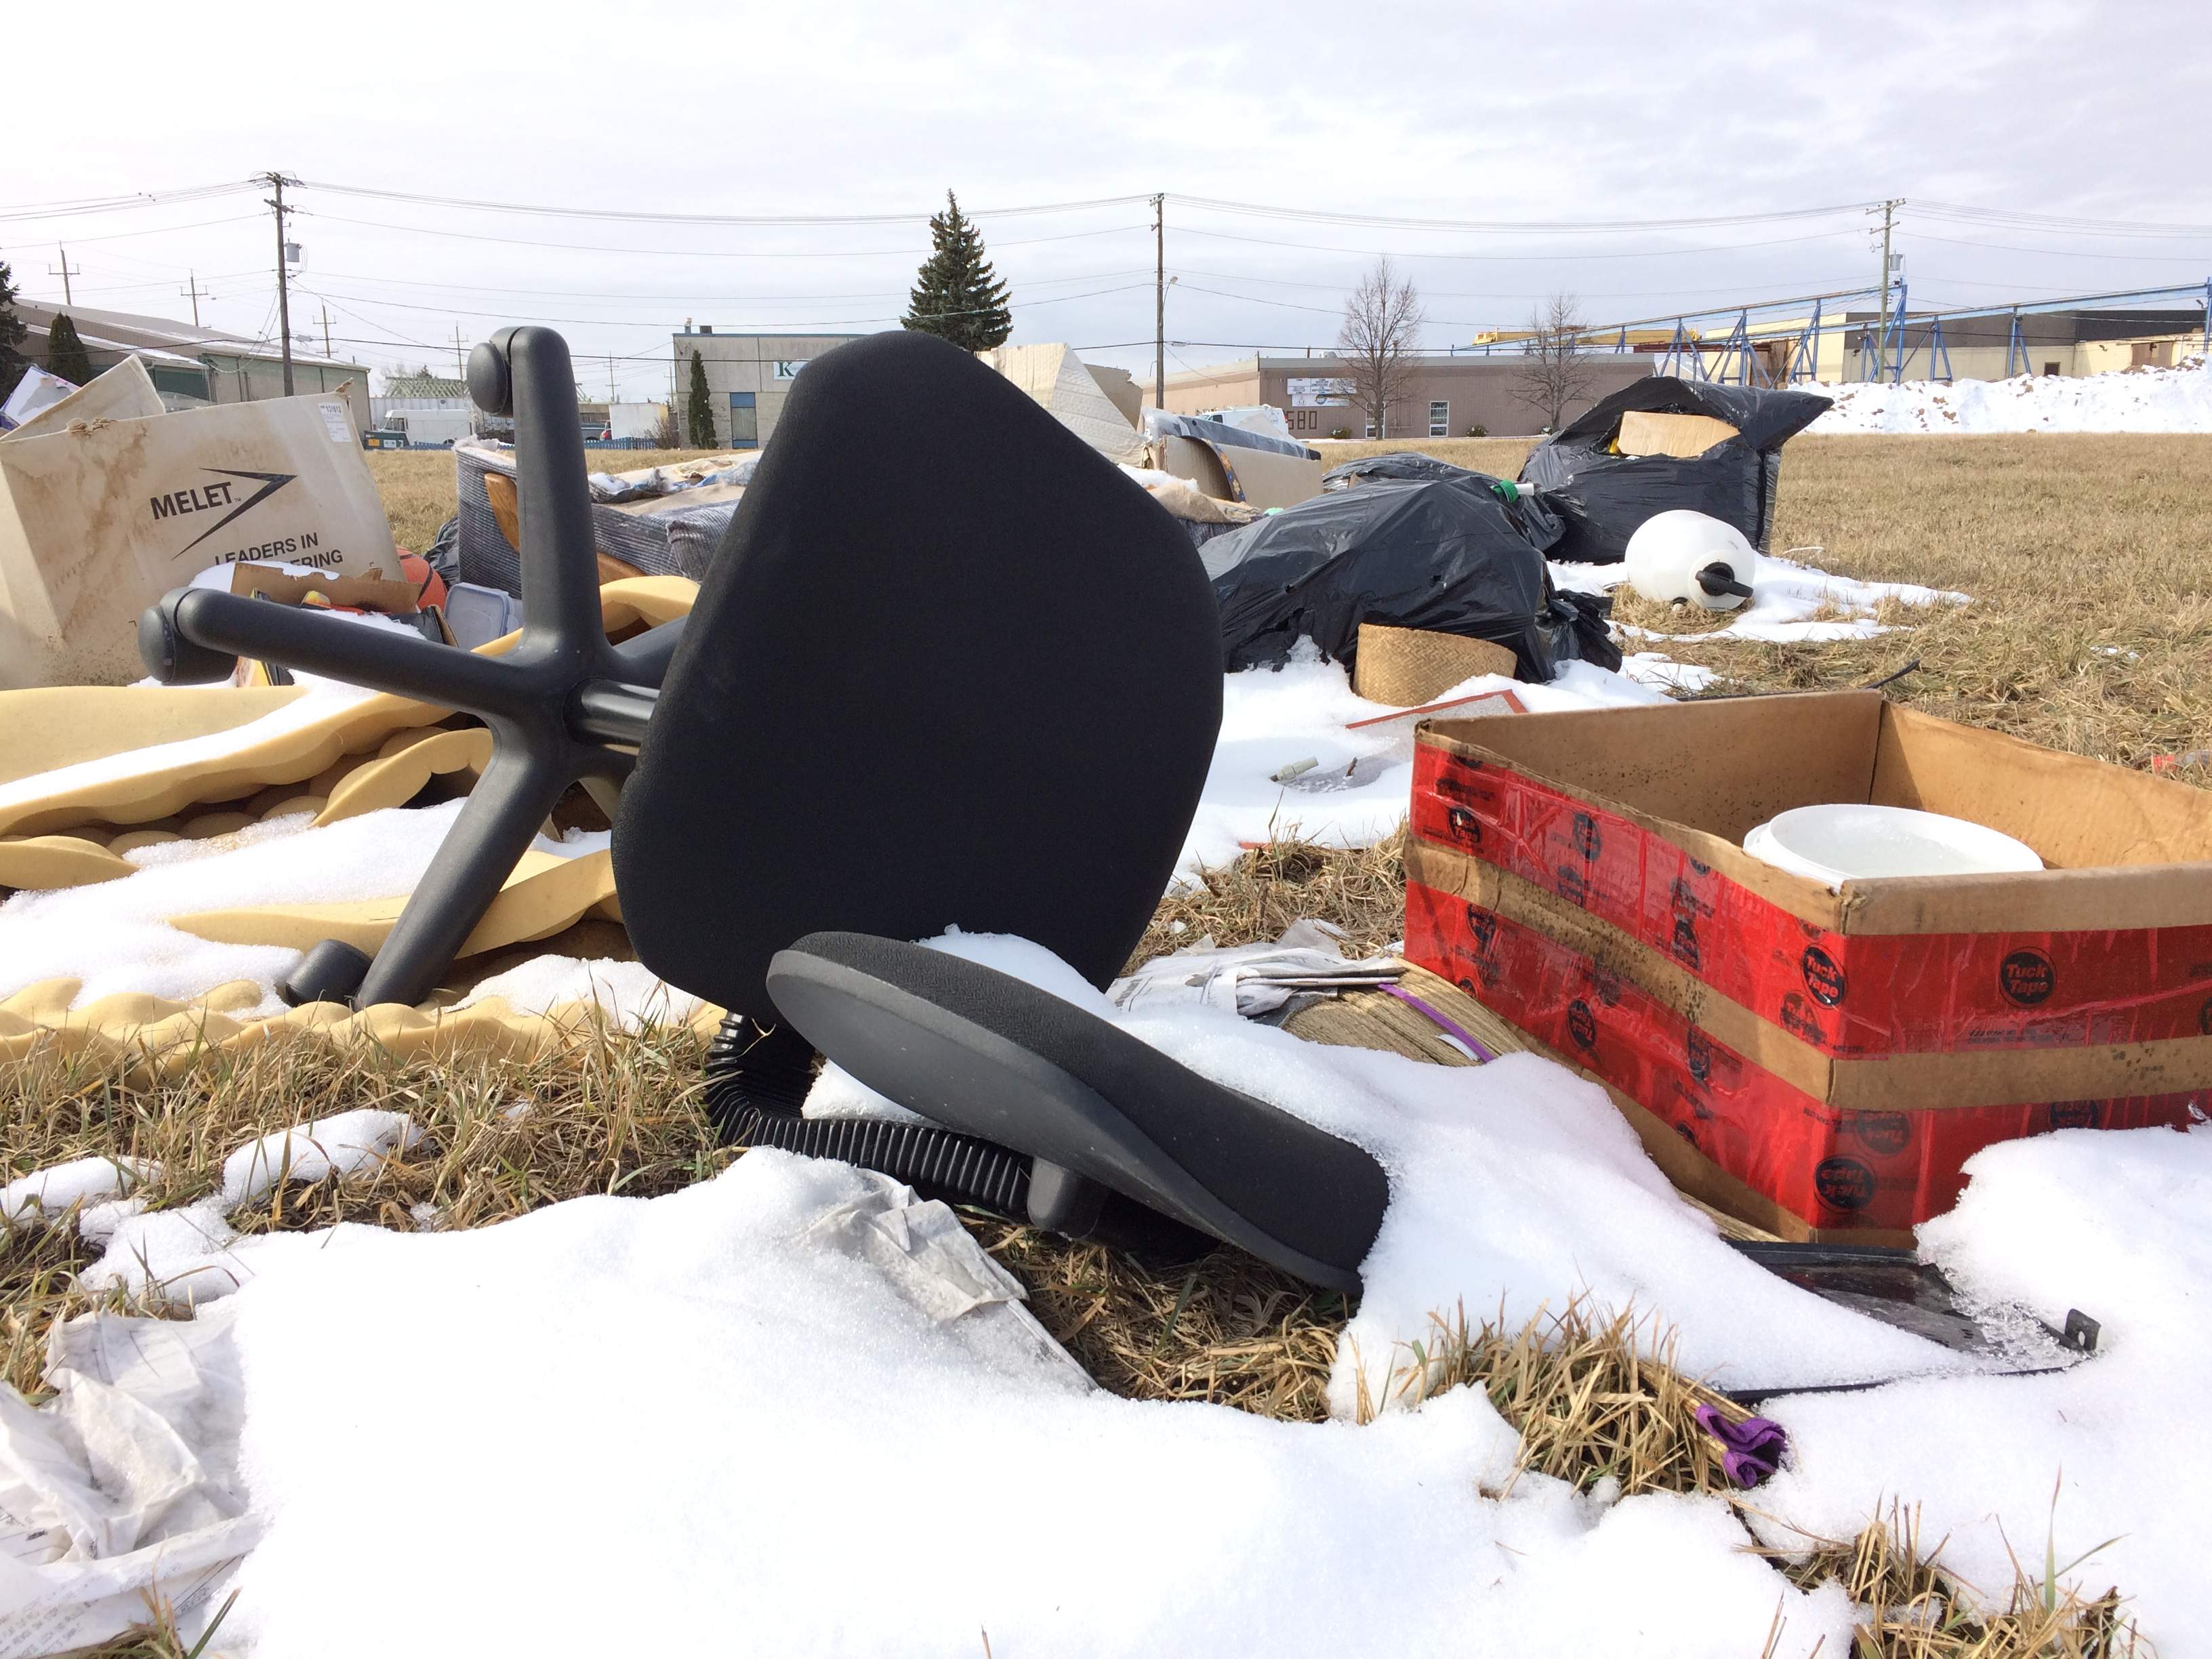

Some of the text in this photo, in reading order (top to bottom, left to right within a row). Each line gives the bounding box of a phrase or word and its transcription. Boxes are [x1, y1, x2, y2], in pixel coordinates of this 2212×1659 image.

[150, 482, 232, 520] MELET
[301, 532, 319, 549] IN
[1807, 956, 1837, 981] Tuck
[2007, 964, 2047, 977] Tuck
[1809, 972, 1839, 998] Tape
[2010, 979, 2049, 996] Tape
